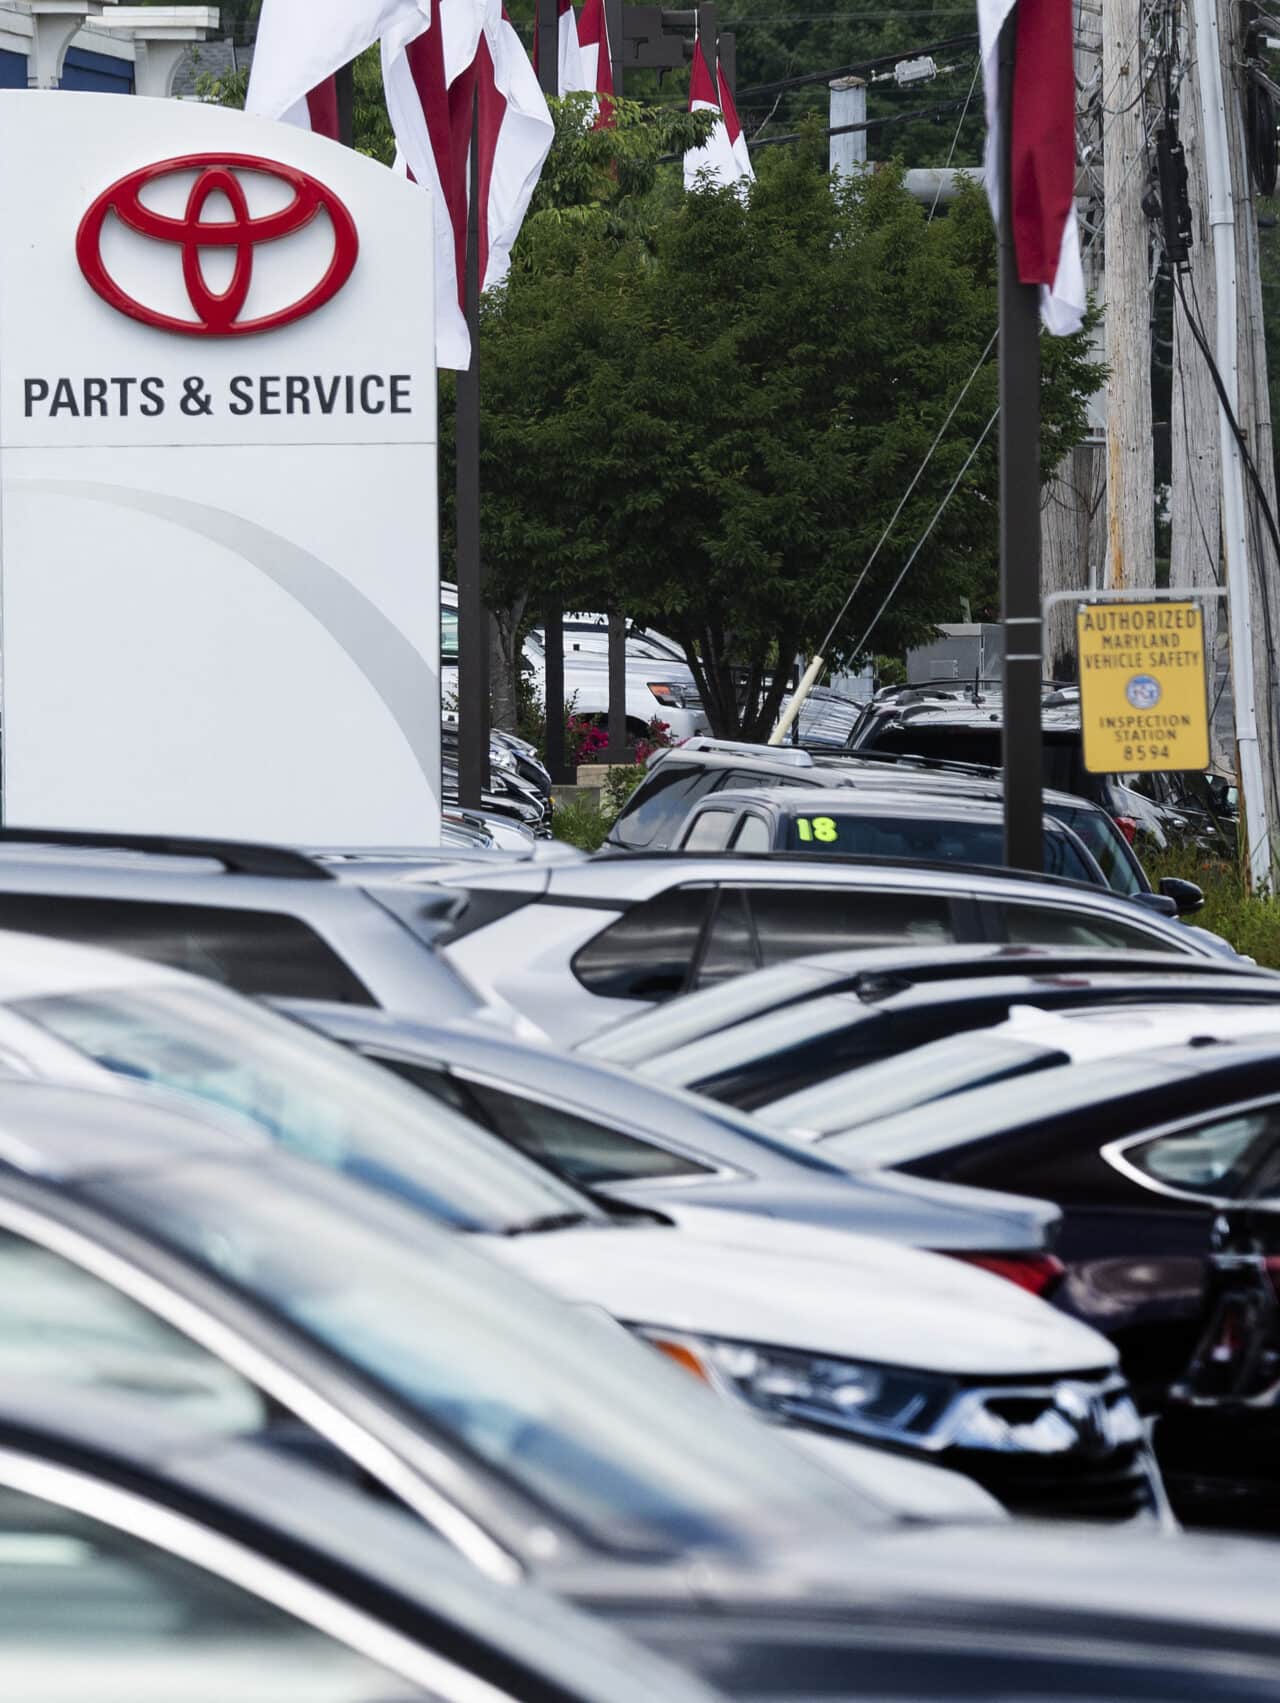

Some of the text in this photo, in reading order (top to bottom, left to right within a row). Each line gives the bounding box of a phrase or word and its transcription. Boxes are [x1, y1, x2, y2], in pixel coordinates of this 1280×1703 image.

[23, 374, 412, 417] PARTS & SERVICE
[1084, 609, 1197, 631] AUTHORIZED
[1102, 633, 1180, 649] MARYLAND
[1084, 651, 1200, 670] VEHICLE SAFETY
[1099, 714, 1191, 729] INSPECTION
[1114, 730, 1177, 743] STATION
[1123, 746, 1169, 761] 8594
[797, 817, 838, 842] 18
